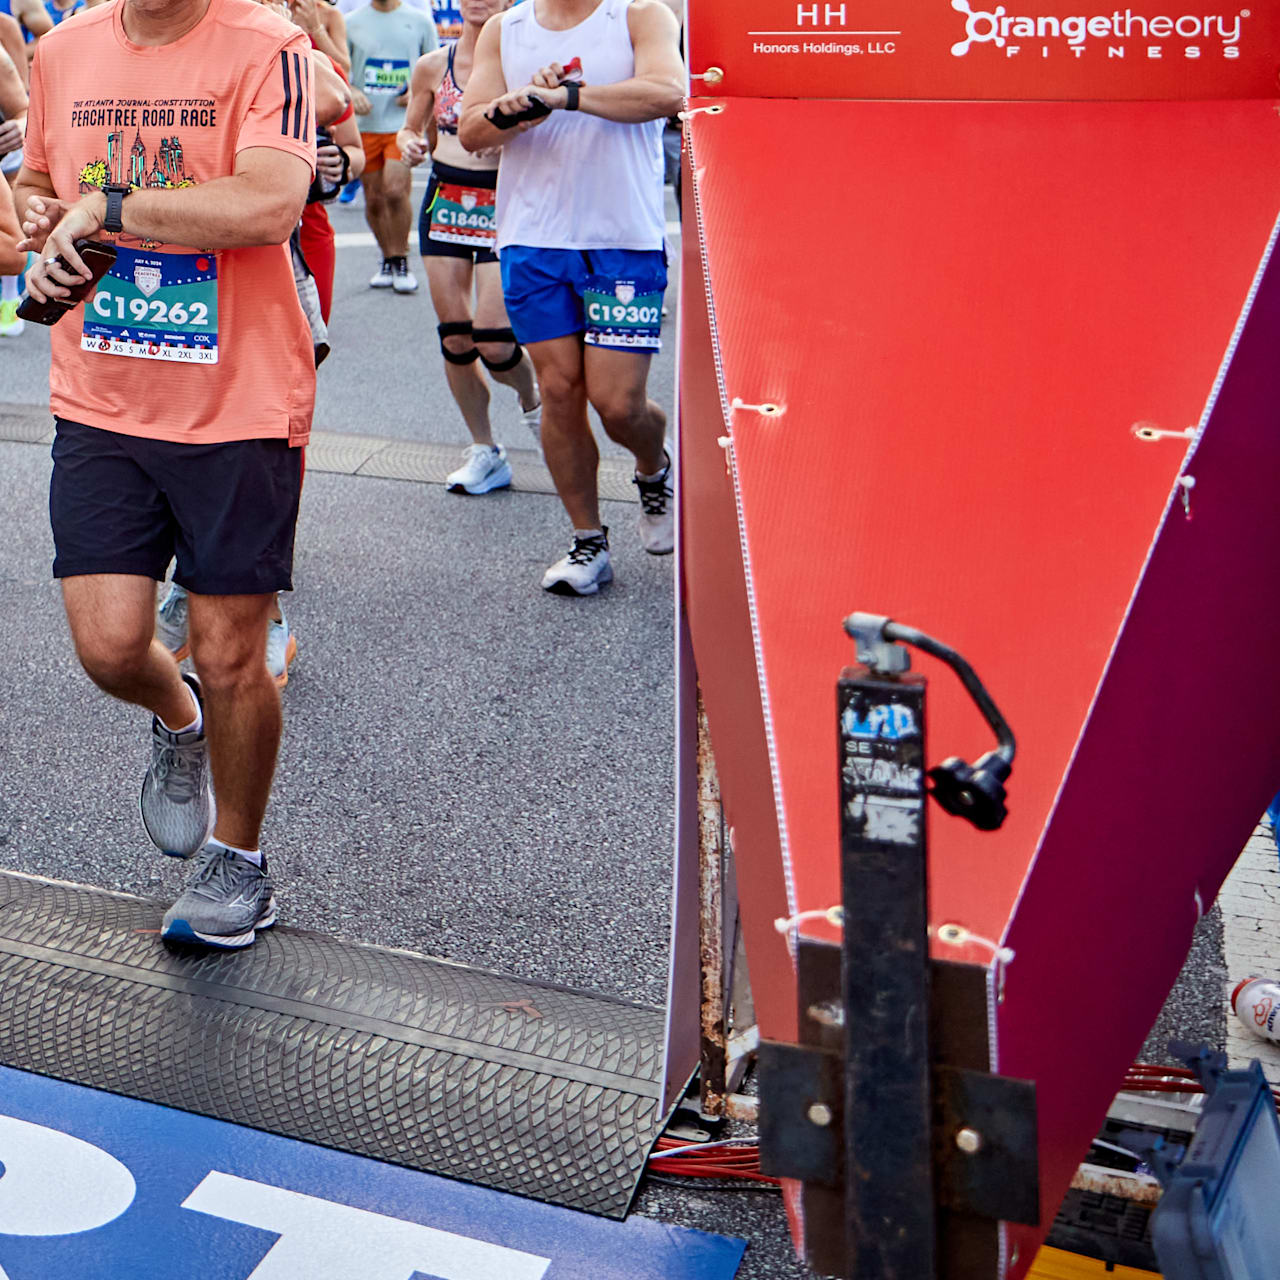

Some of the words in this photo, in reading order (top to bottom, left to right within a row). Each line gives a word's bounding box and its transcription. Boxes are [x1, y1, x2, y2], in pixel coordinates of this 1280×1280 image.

[753, 41, 800, 55] Honors
[802, 41, 865, 58] Holdings,
[867, 42, 896, 55] LLC
[1006, 45, 1240, 58] FITNESS
[84, 99, 114, 108] ATLANTA
[116, 99, 216, 108] JOURNAL-CONSTITUTION
[71, 108, 137, 128] PEACHTREE
[142, 109, 175, 127] ROAD
[180, 109, 217, 127] RACE
[93, 290, 209, 325] C19262
[588, 302, 658, 323] C19302
[193, 335, 210, 343] COX
[113, 344, 124, 352] XS
[129, 346, 134, 354] S
[139, 347, 147, 355] M
[162, 349, 172, 357] XL
[178, 351, 192, 359] 2XL
[198, 352, 213, 360] 3XL
